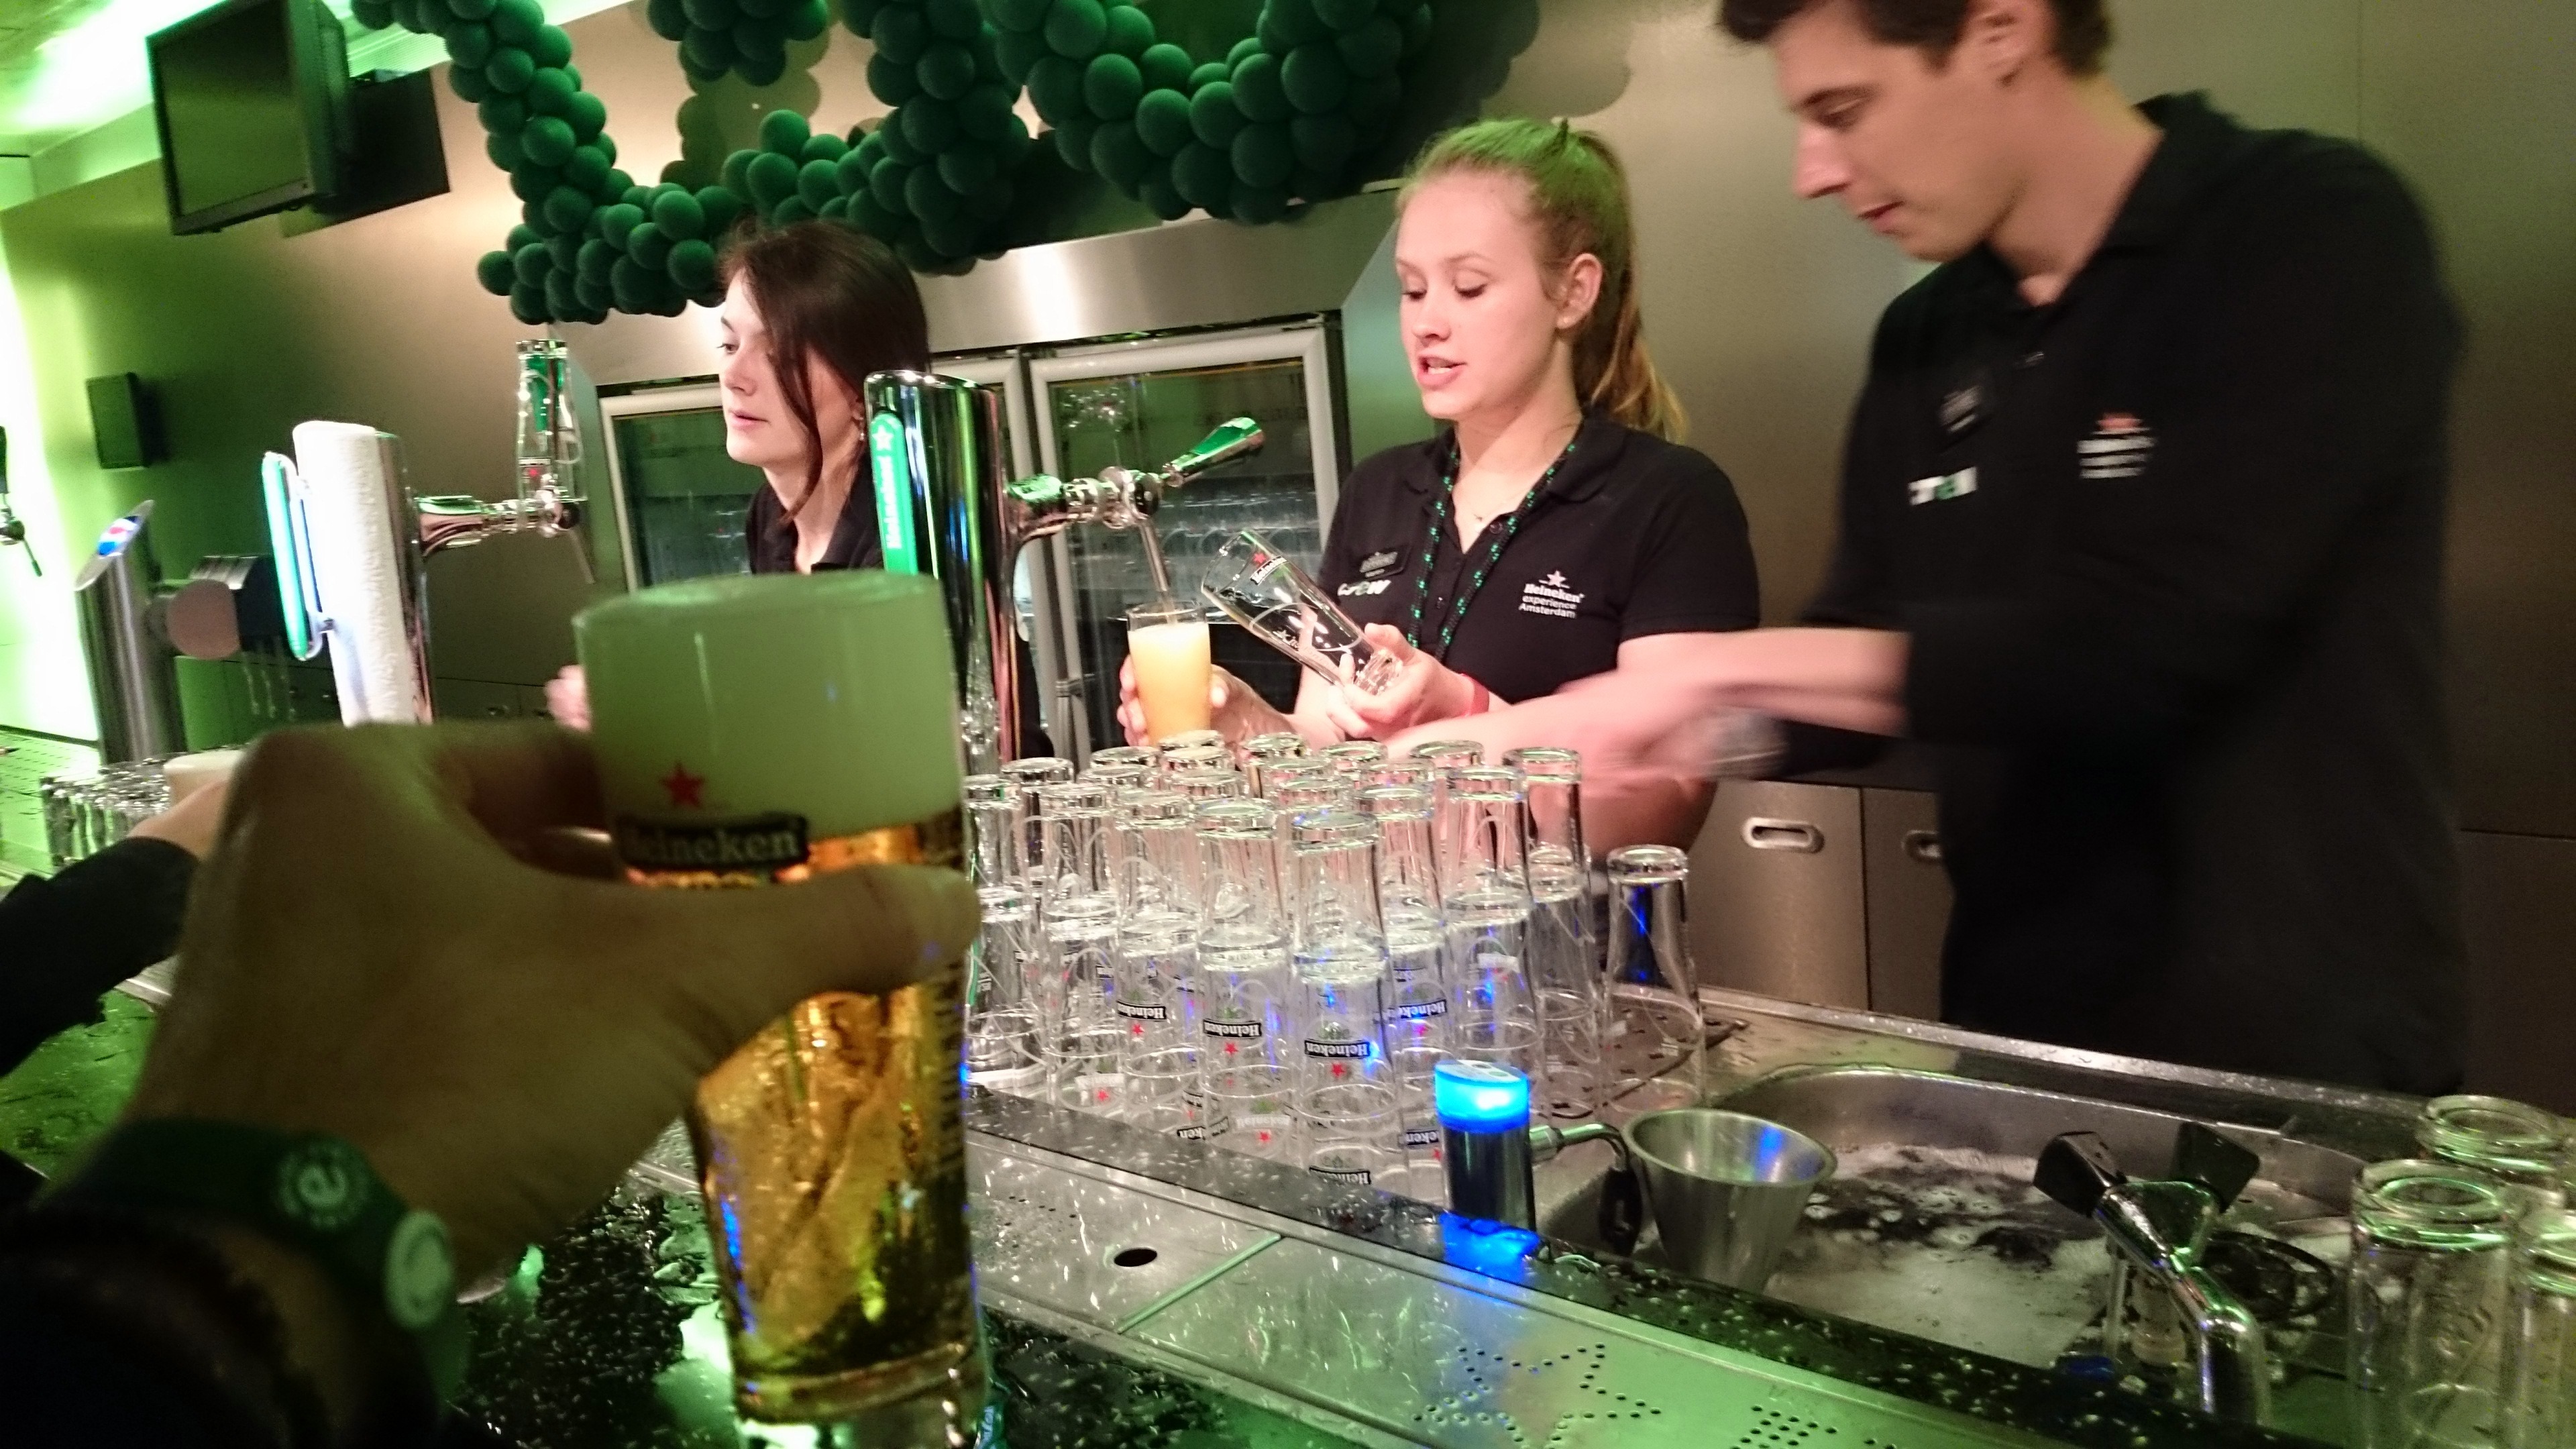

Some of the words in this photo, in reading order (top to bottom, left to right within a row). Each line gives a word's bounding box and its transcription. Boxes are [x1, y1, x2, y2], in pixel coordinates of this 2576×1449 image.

[1523, 583, 1581, 603] Heineken
[1518, 602, 1576, 618] Amsterdam
[1521, 595, 1577, 610] experience
[1397, 1001, 1446, 1018] Heinek
[1204, 1021, 1260, 1036] Heineken
[1306, 1040, 1368, 1057] Heineken
